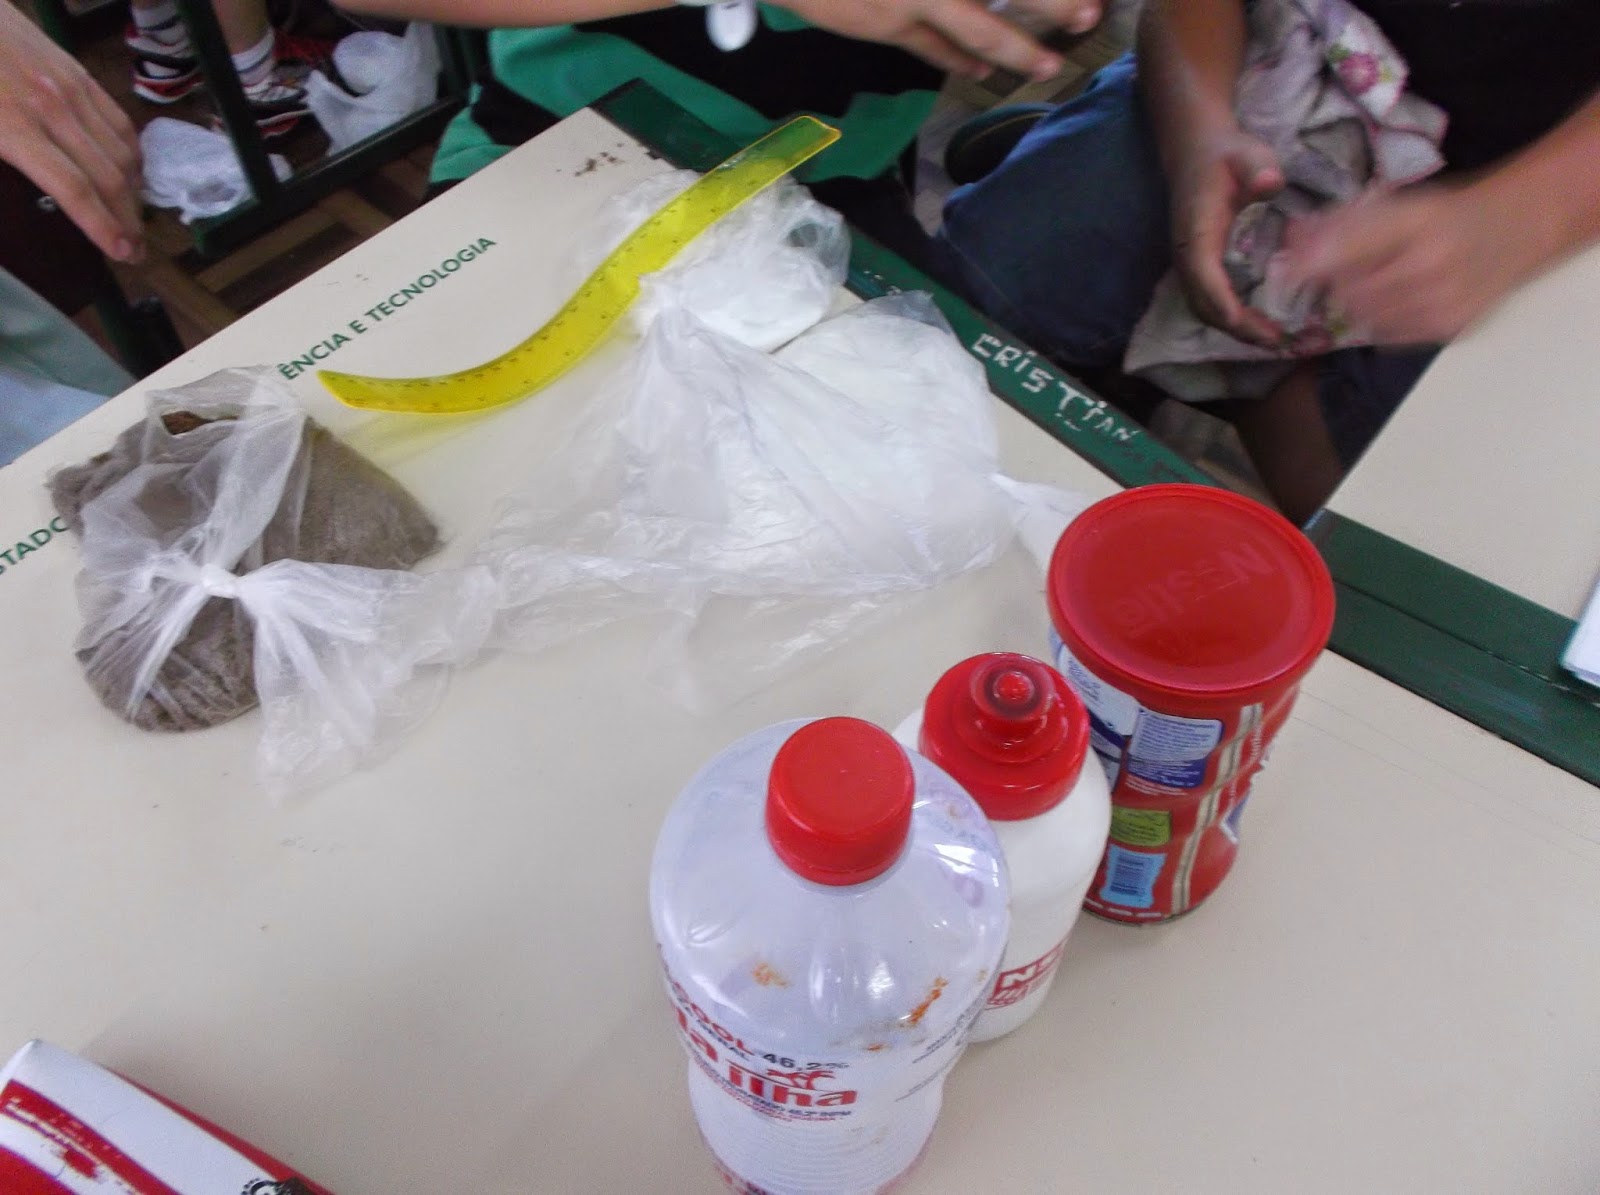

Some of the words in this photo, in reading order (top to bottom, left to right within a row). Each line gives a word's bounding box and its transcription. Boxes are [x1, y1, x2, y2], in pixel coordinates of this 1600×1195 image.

[349, 319, 368, 334] E
[365, 237, 497, 322] TECNOLOGIA
[728, 1064, 857, 1107] ilha
